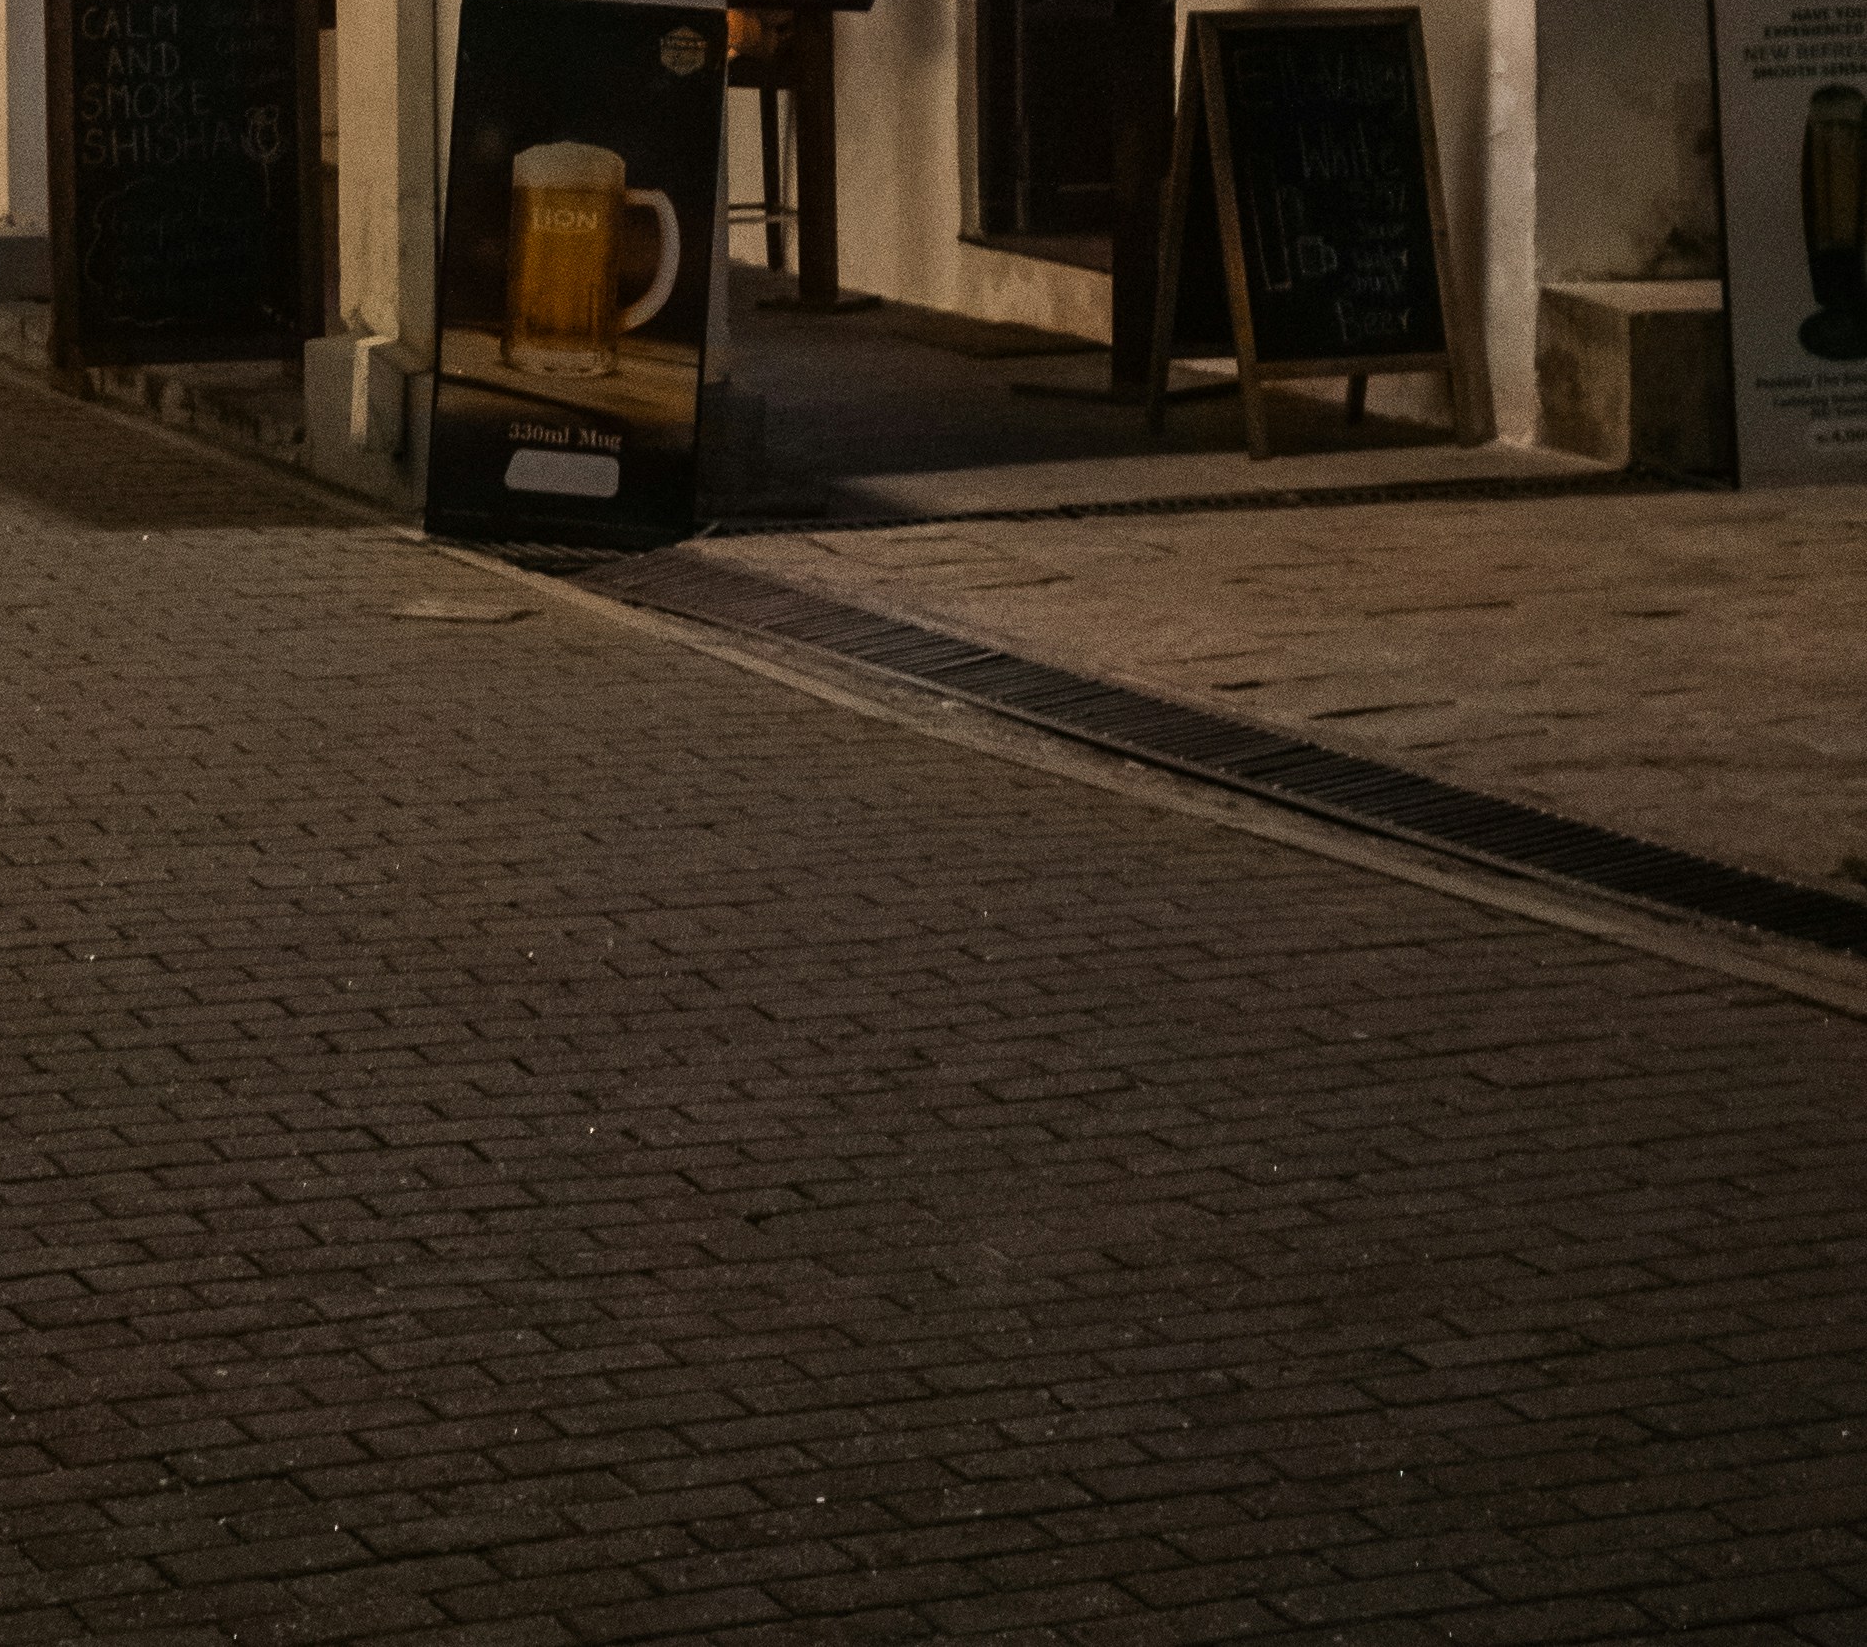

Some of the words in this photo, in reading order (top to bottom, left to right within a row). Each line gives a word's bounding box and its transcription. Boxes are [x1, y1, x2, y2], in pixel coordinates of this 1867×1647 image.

[80, 4, 179, 40] CALM
[106, 41, 182, 79] AND
[81, 80, 212, 121] SMOKE
[81, 120, 235, 168] SHISHA
[507, 420, 571, 445] 330ml
[576, 426, 624, 453] Mug
